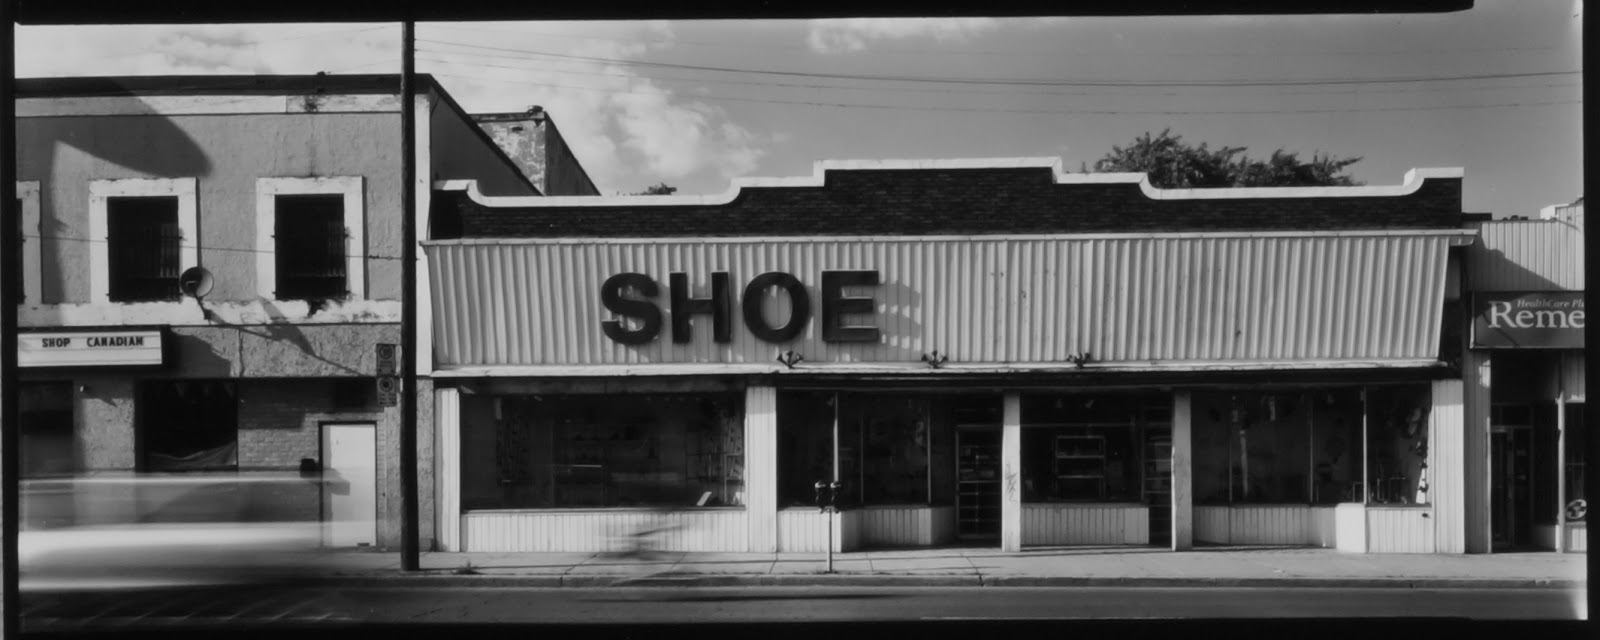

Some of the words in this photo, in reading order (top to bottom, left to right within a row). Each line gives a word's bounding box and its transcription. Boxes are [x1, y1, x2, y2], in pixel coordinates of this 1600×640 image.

[601, 270, 880, 346] SHOE
[1488, 301, 1585, 328] Reme
[42, 338, 71, 348] SHOP
[86, 336, 144, 348] CANADIAN
